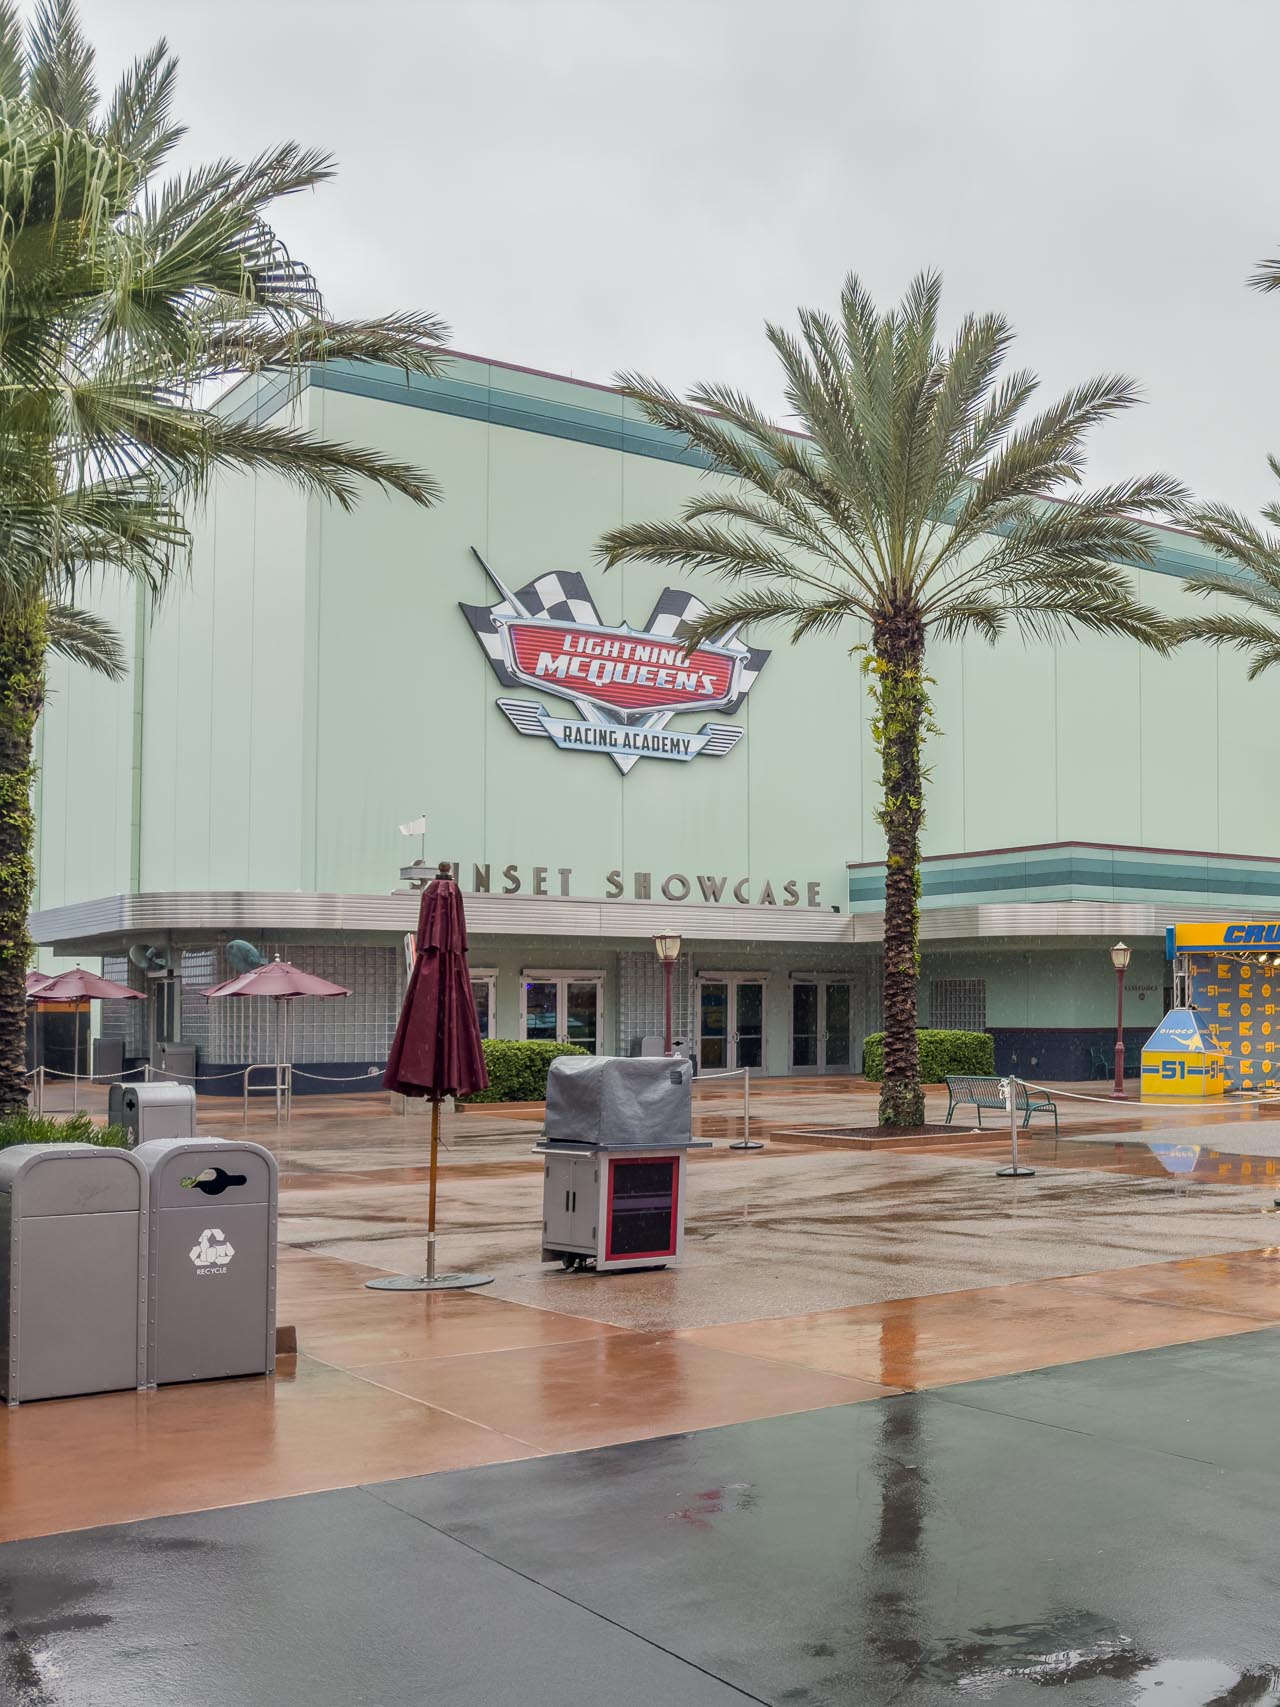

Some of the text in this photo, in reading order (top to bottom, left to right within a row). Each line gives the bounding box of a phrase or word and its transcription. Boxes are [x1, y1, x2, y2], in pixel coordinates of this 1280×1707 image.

[562, 634, 691, 668] LIGHTNING
[534, 652, 718, 695] MCQUEEN'S
[563, 725, 691, 756] RACING ACADEMY
[410, 862, 822, 907] NSET SHOWCASE
[1162, 1060, 1186, 1080] 51
[196, 1267, 228, 1275] RECYCLE
